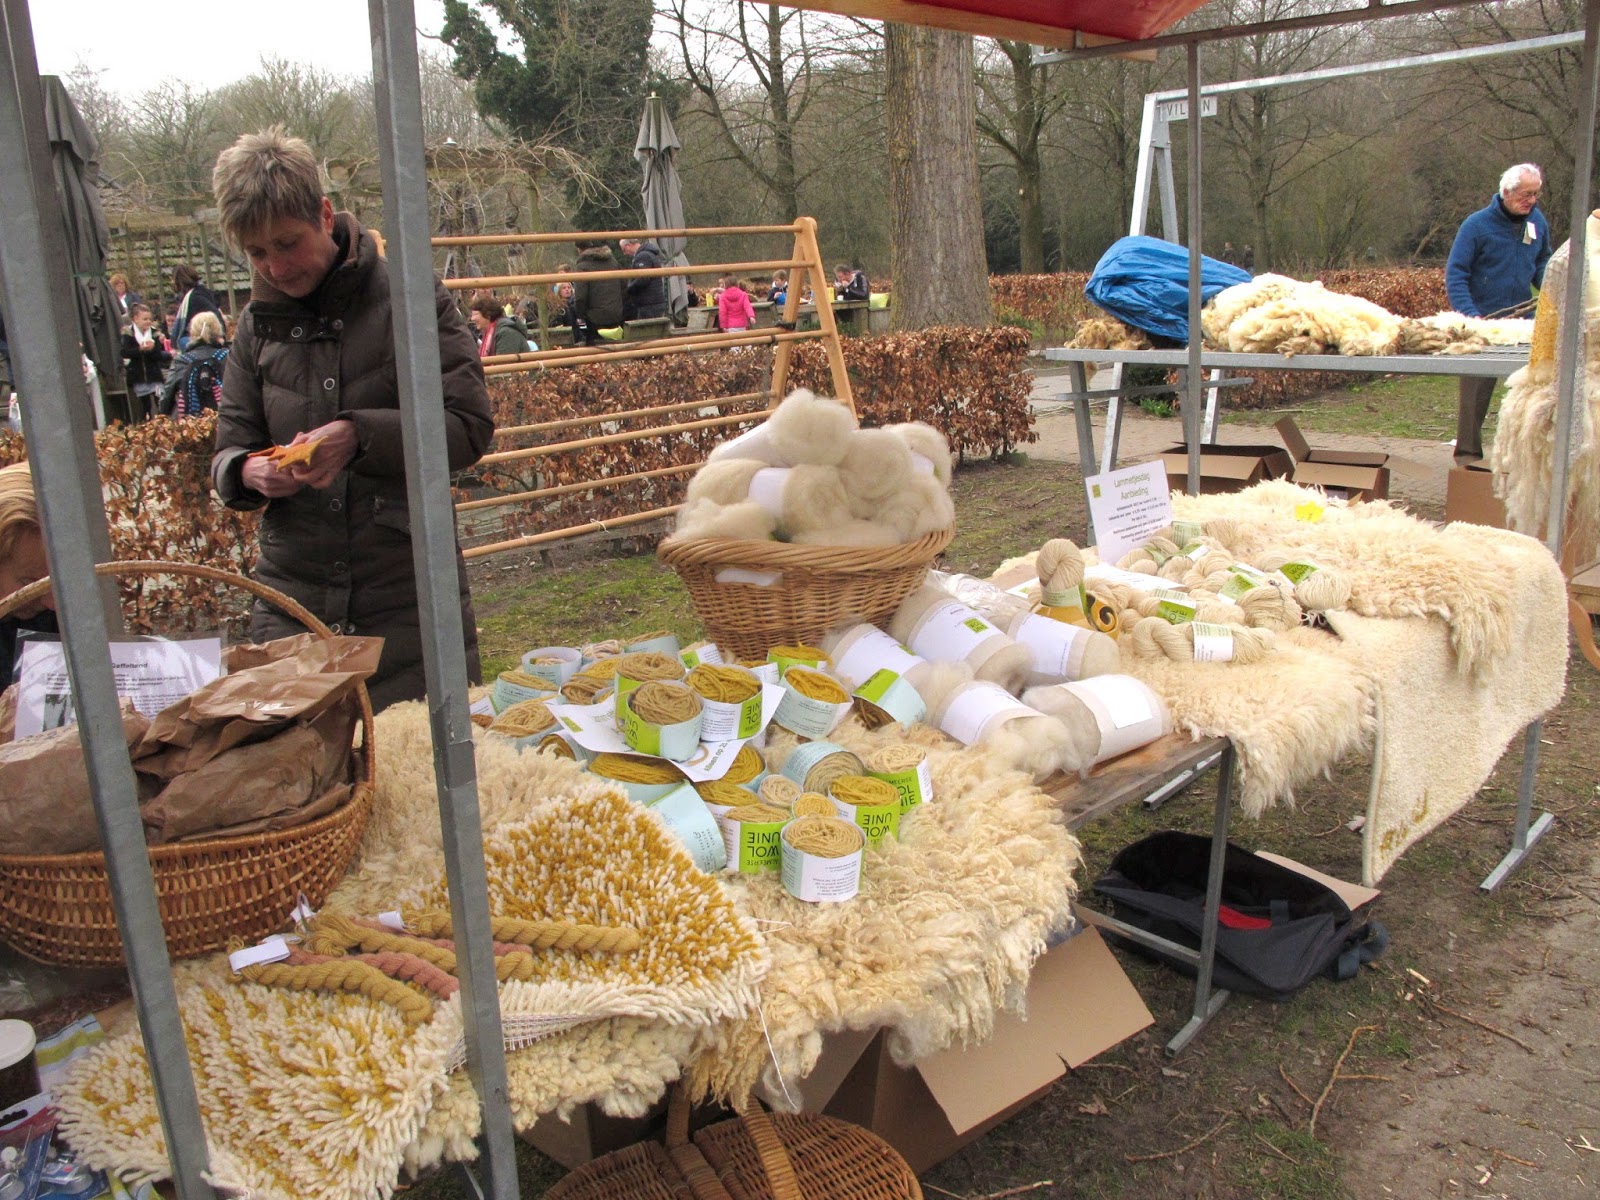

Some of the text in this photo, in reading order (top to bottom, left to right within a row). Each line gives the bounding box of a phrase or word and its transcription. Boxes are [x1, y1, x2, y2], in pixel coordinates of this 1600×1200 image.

[1166, 99, 1211, 116] VILN
[1120, 487, 1149, 501] Aanbieding
[746, 713, 759, 725] OL
[897, 785, 914, 796] OL
[862, 812, 892, 825] UNIE
[747, 831, 781, 844] UNIE
[747, 845, 779, 858] WOL
